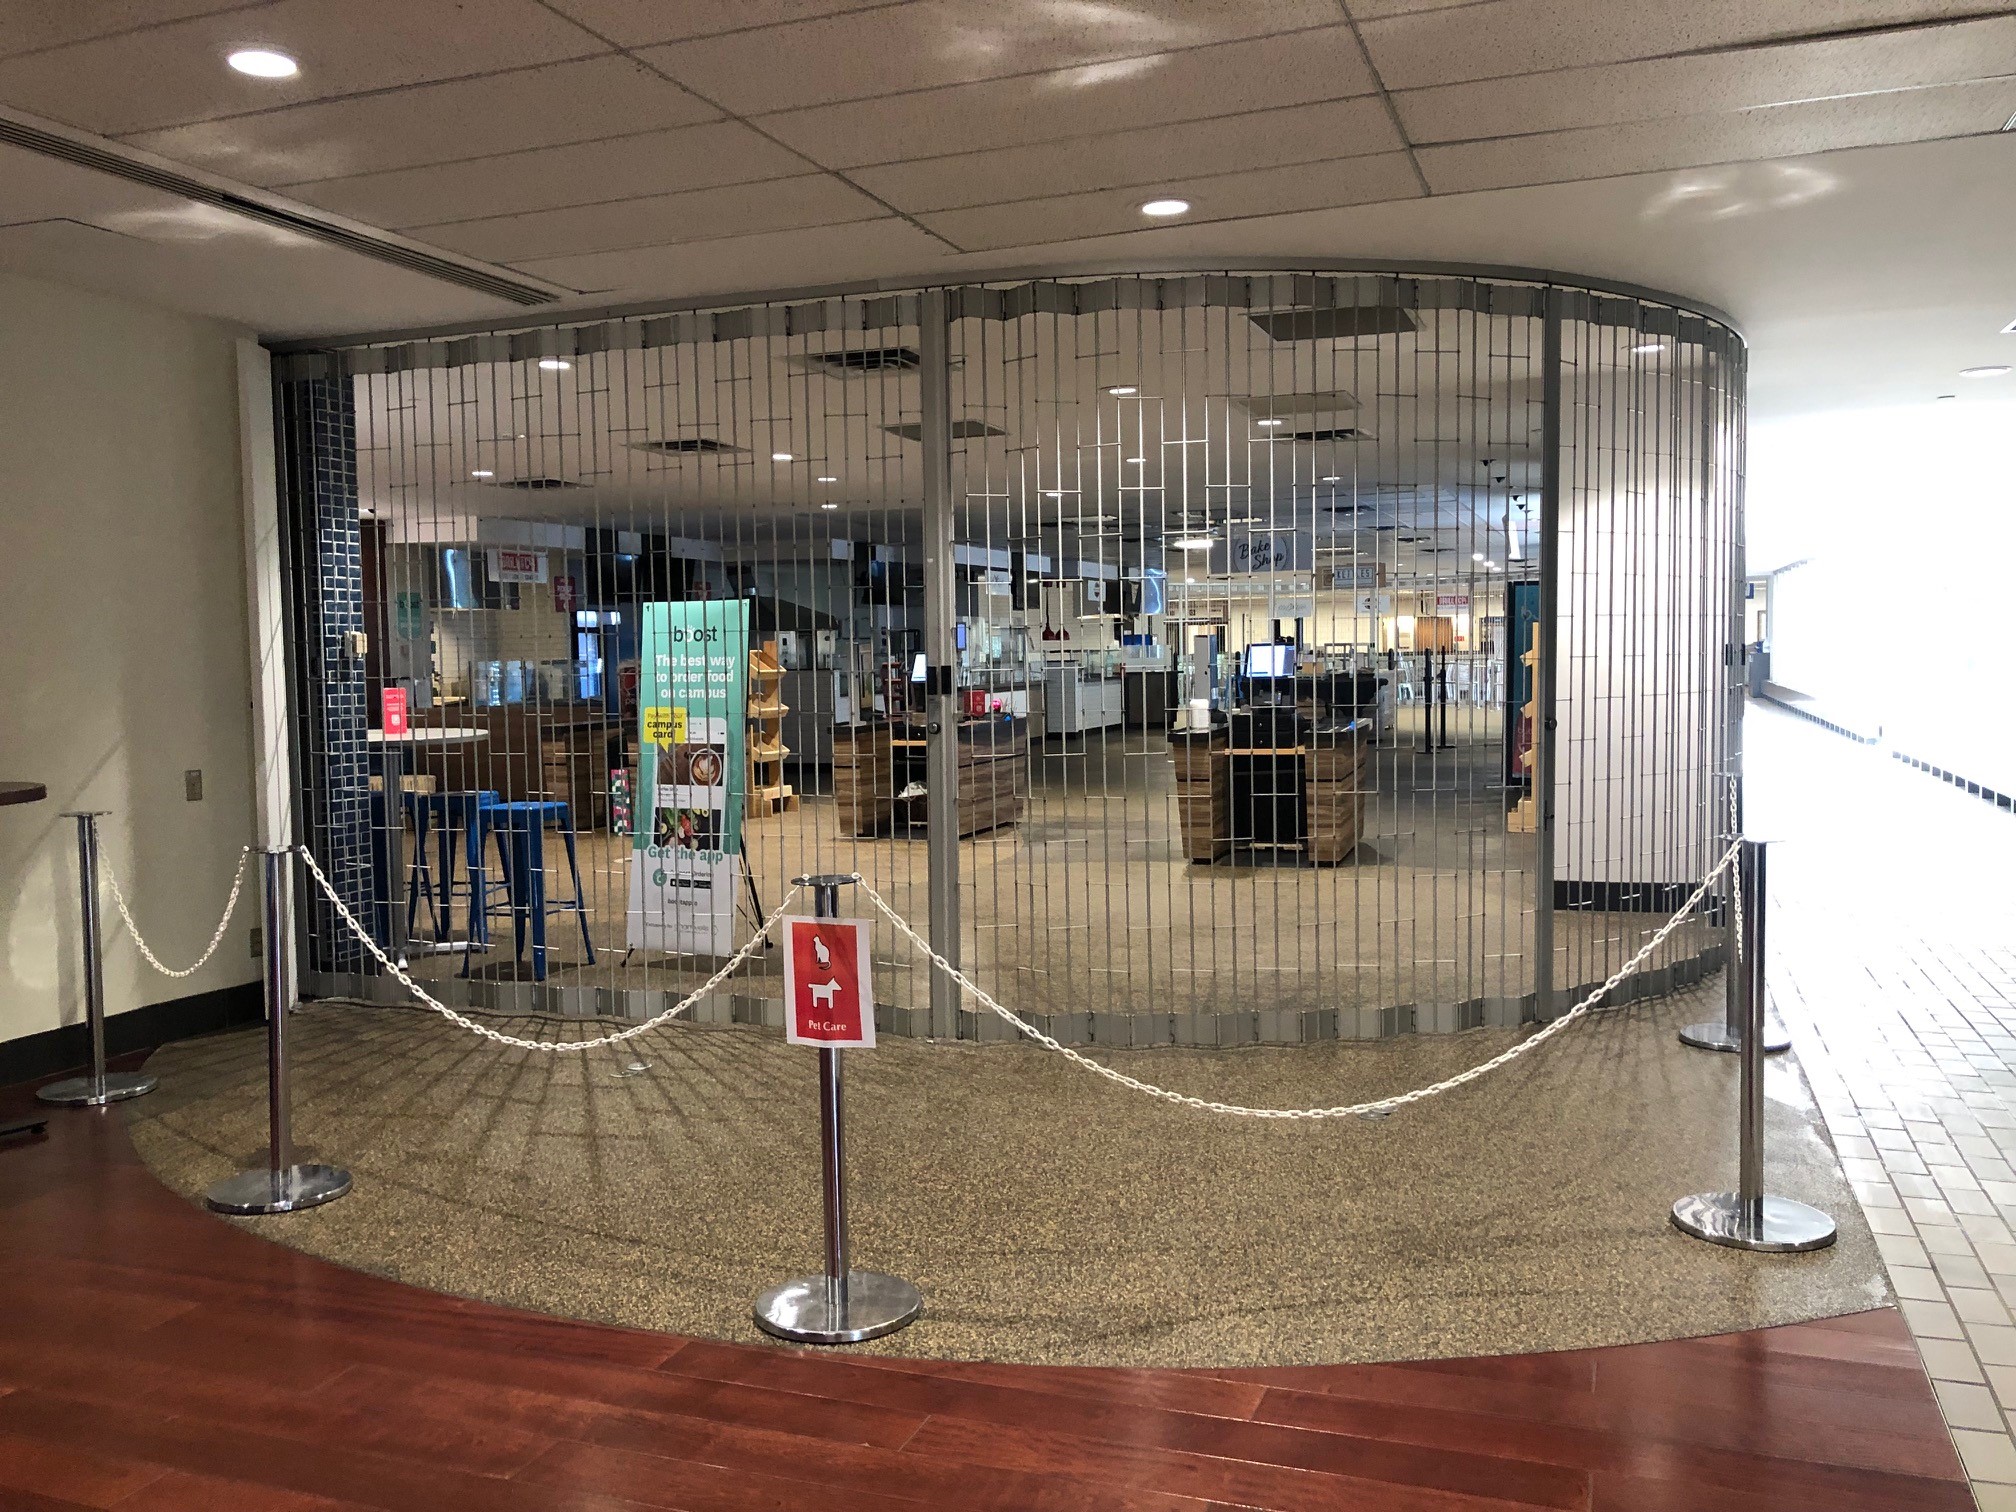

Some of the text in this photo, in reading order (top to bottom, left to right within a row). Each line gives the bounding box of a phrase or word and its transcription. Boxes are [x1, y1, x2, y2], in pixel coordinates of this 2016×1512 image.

[1239, 540, 1271, 559] Bake
[674, 625, 718, 643] boost
[656, 654, 736, 669] The best way
[656, 670, 734, 683] to order food
[661, 688, 727, 701] on campus
[647, 721, 683, 739] campus card
[648, 846, 724, 865] Get he app
[808, 1019, 847, 1032] Pet Care
